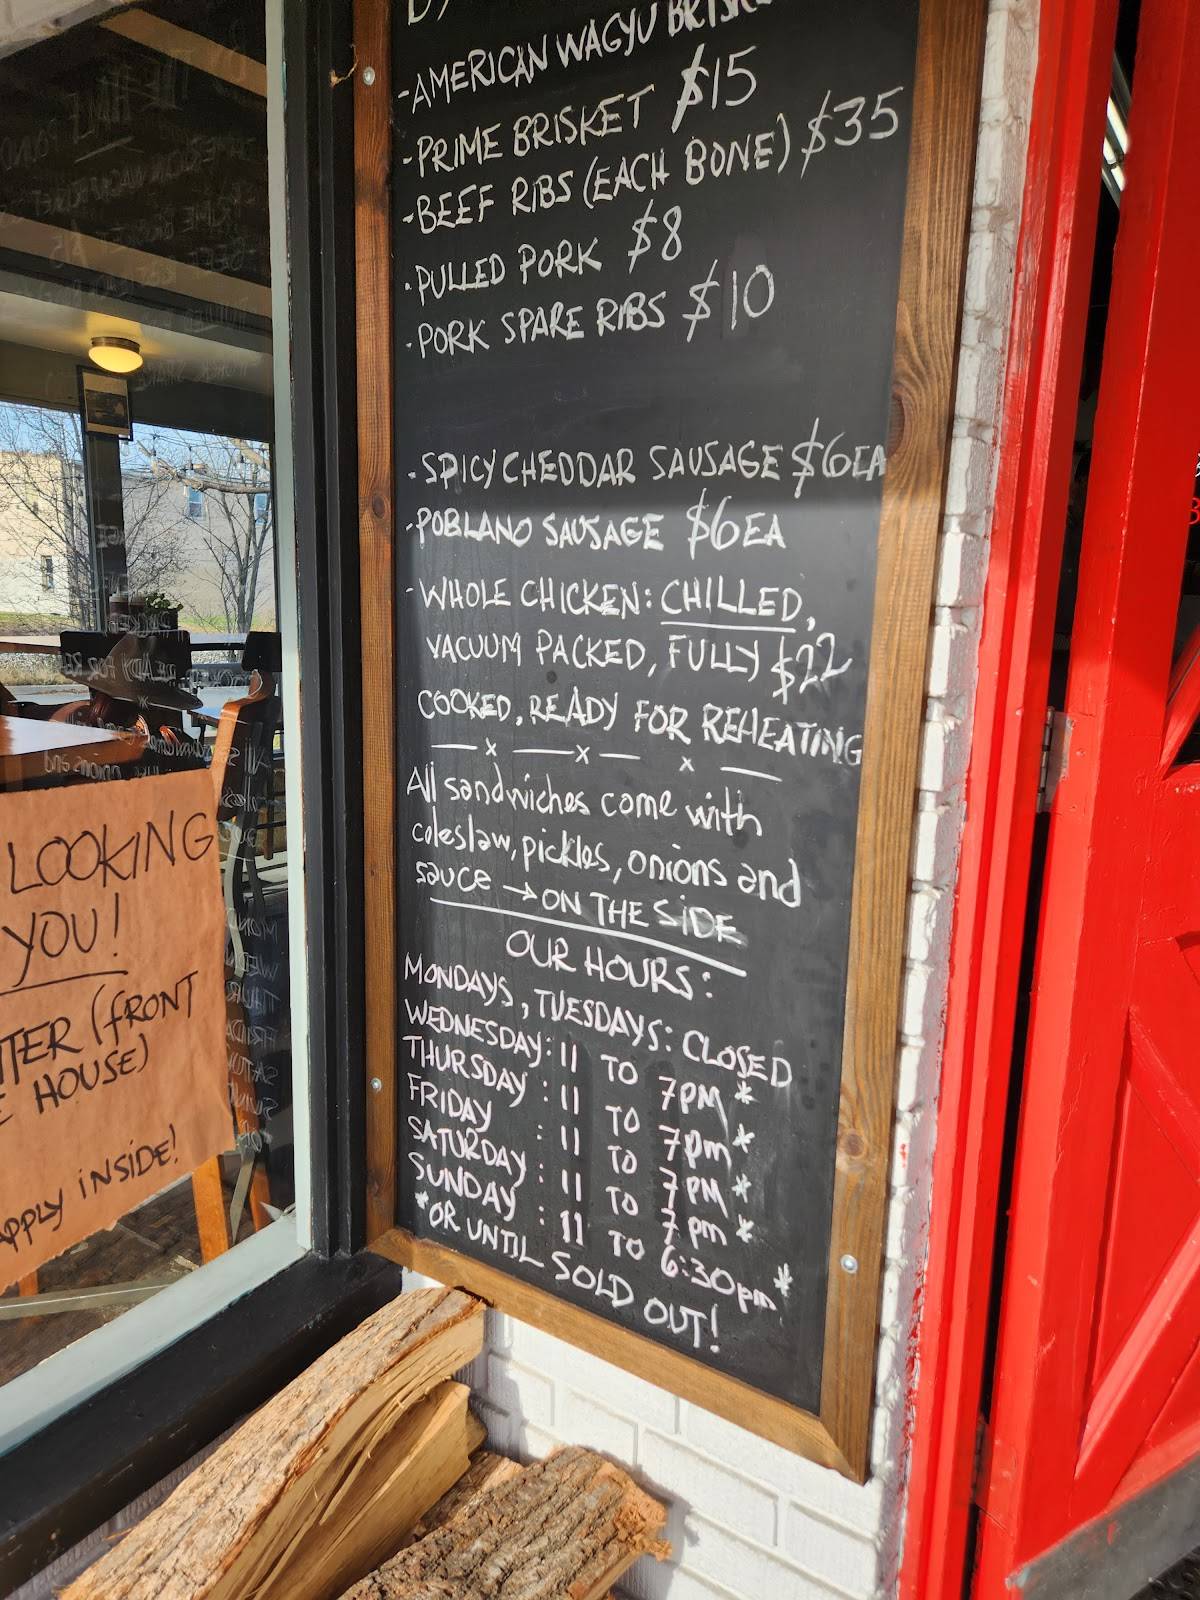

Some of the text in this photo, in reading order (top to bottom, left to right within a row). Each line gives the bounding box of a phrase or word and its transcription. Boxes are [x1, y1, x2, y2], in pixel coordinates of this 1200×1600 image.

[556, 4, 657, 67] WAGYU
[512, 84, 655, 157] BRISKET
[672, 43, 757, 132] $15
[511, 169, 573, 216] RIBS
[582, 148, 669, 209] (EACH
[685, 113, 791, 185] BONE)
[801, 87, 904, 177] $35
[518, 238, 602, 285] PORK
[628, 199, 682, 273] $8
[500, 302, 584, 345] SPARE
[596, 290, 666, 336] RIBS
[683, 259, 775, 343] $10
[502, 449, 636, 487] CHEDDAR
[649, 441, 782, 482] SAUSAGE
[545, 513, 665, 551] SAUSAGE
[521, 576, 653, 617] CHICKEN:
[427, 630, 853, 704] VACUUM PACKED, FULLY $22
[418, 686, 863, 767] COOKED, READY FOR REHEATING
[407, 761, 762, 836] All sandwiches come with
[8, 810, 214, 894] LOOKING
[412, 806, 802, 908] coleslaw, pickles, onions and
[415, 861, 492, 892] sauce
[542, 887, 583, 916] ON
[589, 891, 650, 928] THE
[1, 892, 120, 987] YOU!
[506, 930, 714, 1000] OUR HOURS:
[33, 1033, 149, 1114] HOUSE)
[533, 988, 673, 1051] TUESDAYS:
[682, 1030, 792, 1088] CLOSED
[560, 1041, 578, 1074] 11
[600, 1054, 639, 1086] TO
[560, 1083, 579, 1115] 11
[605, 1106, 641, 1137] TO
[560, 1125, 579, 1156] 11
[607, 1146, 638, 1174] TO
[561, 1170, 581, 1201] 11
[605, 1186, 639, 1216] TO
[608, 1229, 645, 1260] TO
[466, 1217, 544, 1268] UNTIL
[551, 1250, 635, 1308] SOLD
[643, 1297, 720, 1352] OUT!
